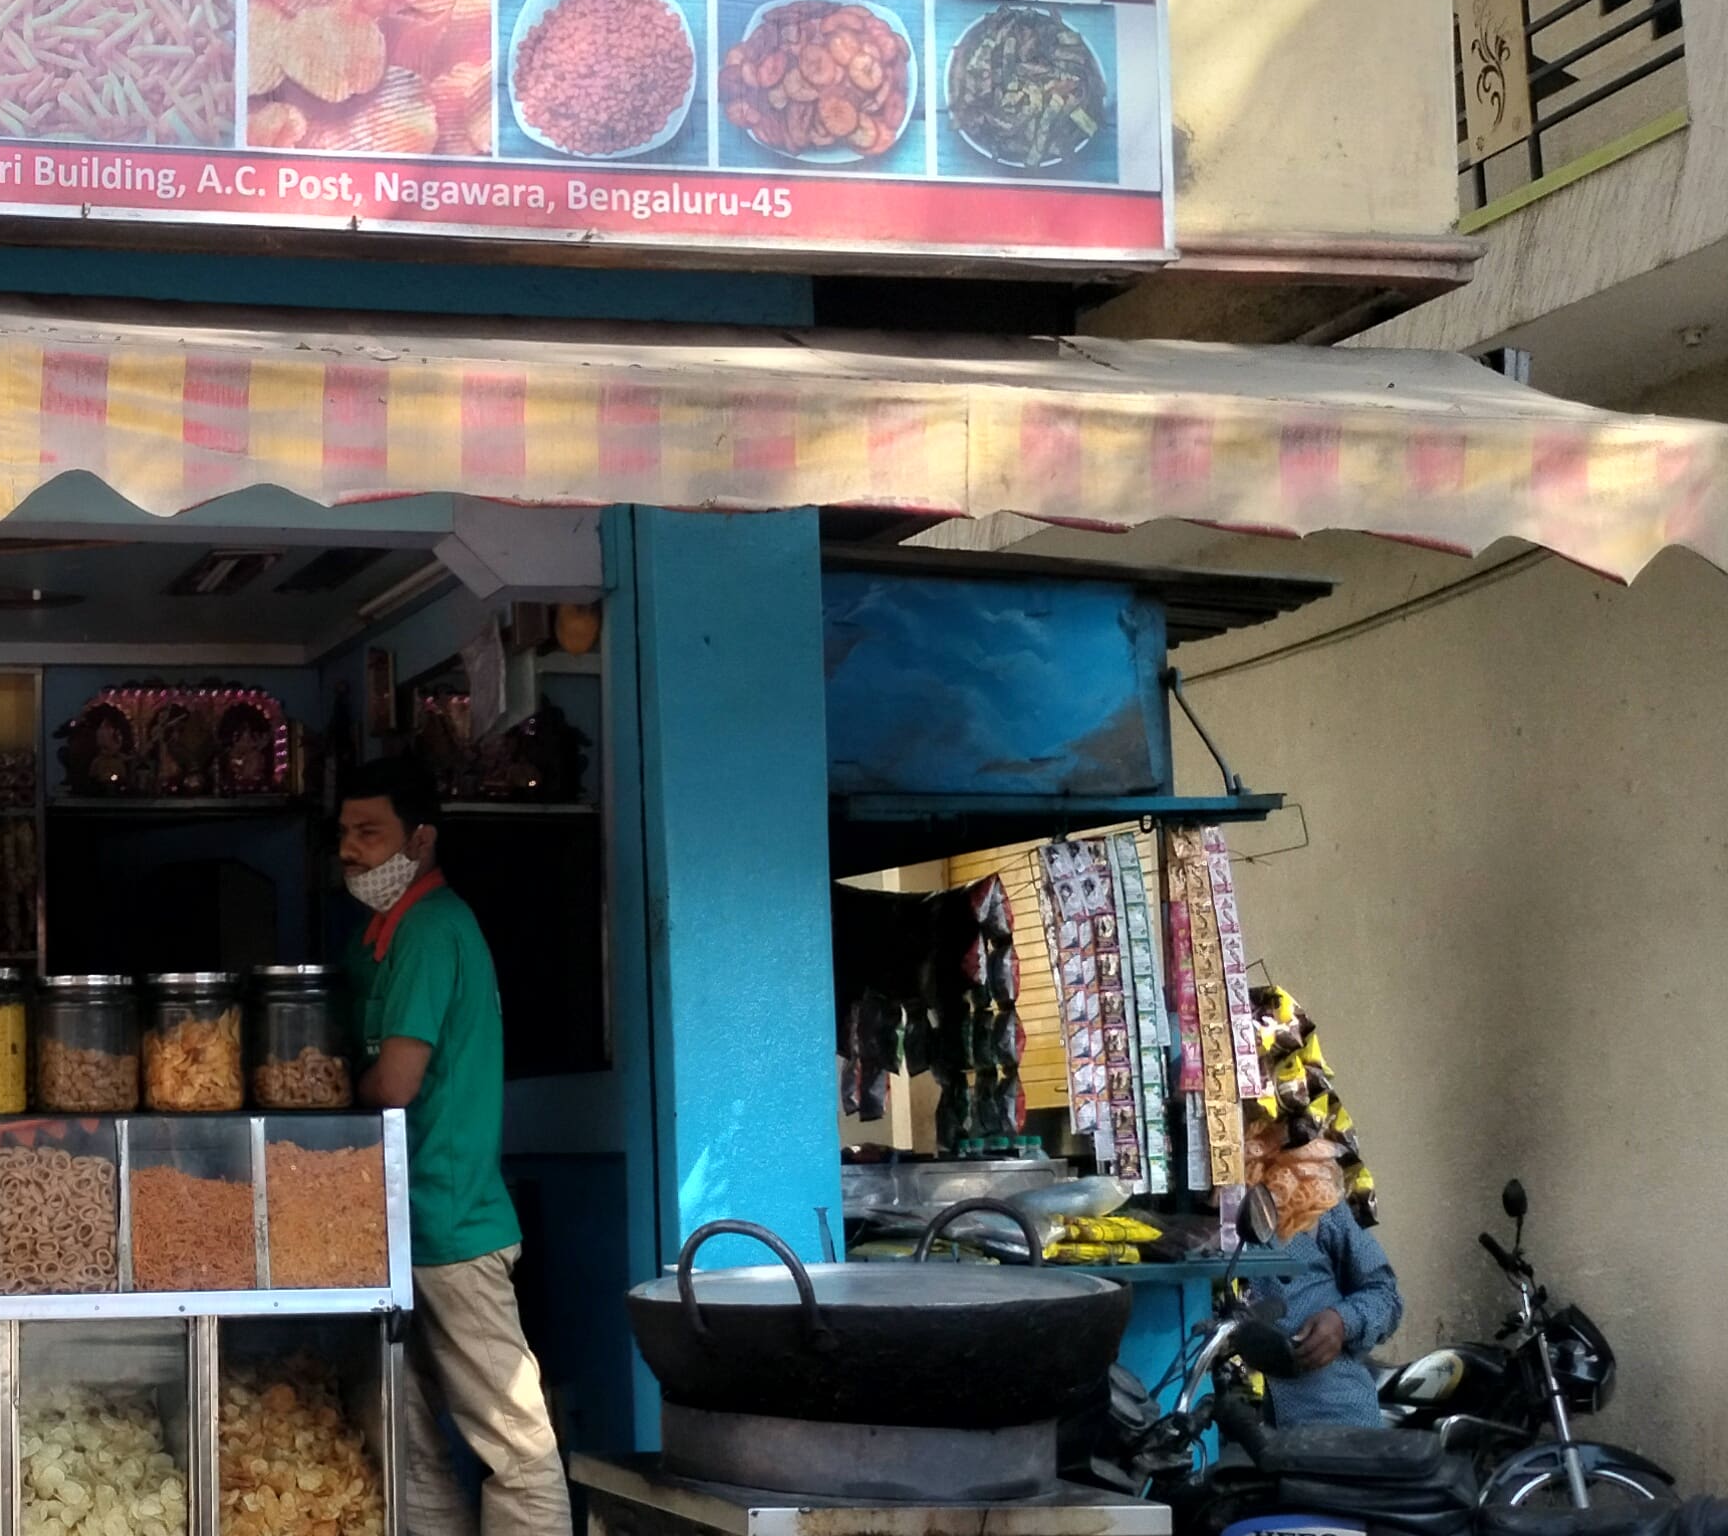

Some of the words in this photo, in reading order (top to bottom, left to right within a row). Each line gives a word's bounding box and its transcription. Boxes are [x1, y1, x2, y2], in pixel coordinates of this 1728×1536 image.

[34, 155, 186, 200] Building,
[197, 163, 266, 197] A.C.
[278, 167, 364, 206] Post,
[374, 171, 557, 213] Nagawara,
[567, 180, 793, 219] Bengaluru-45
